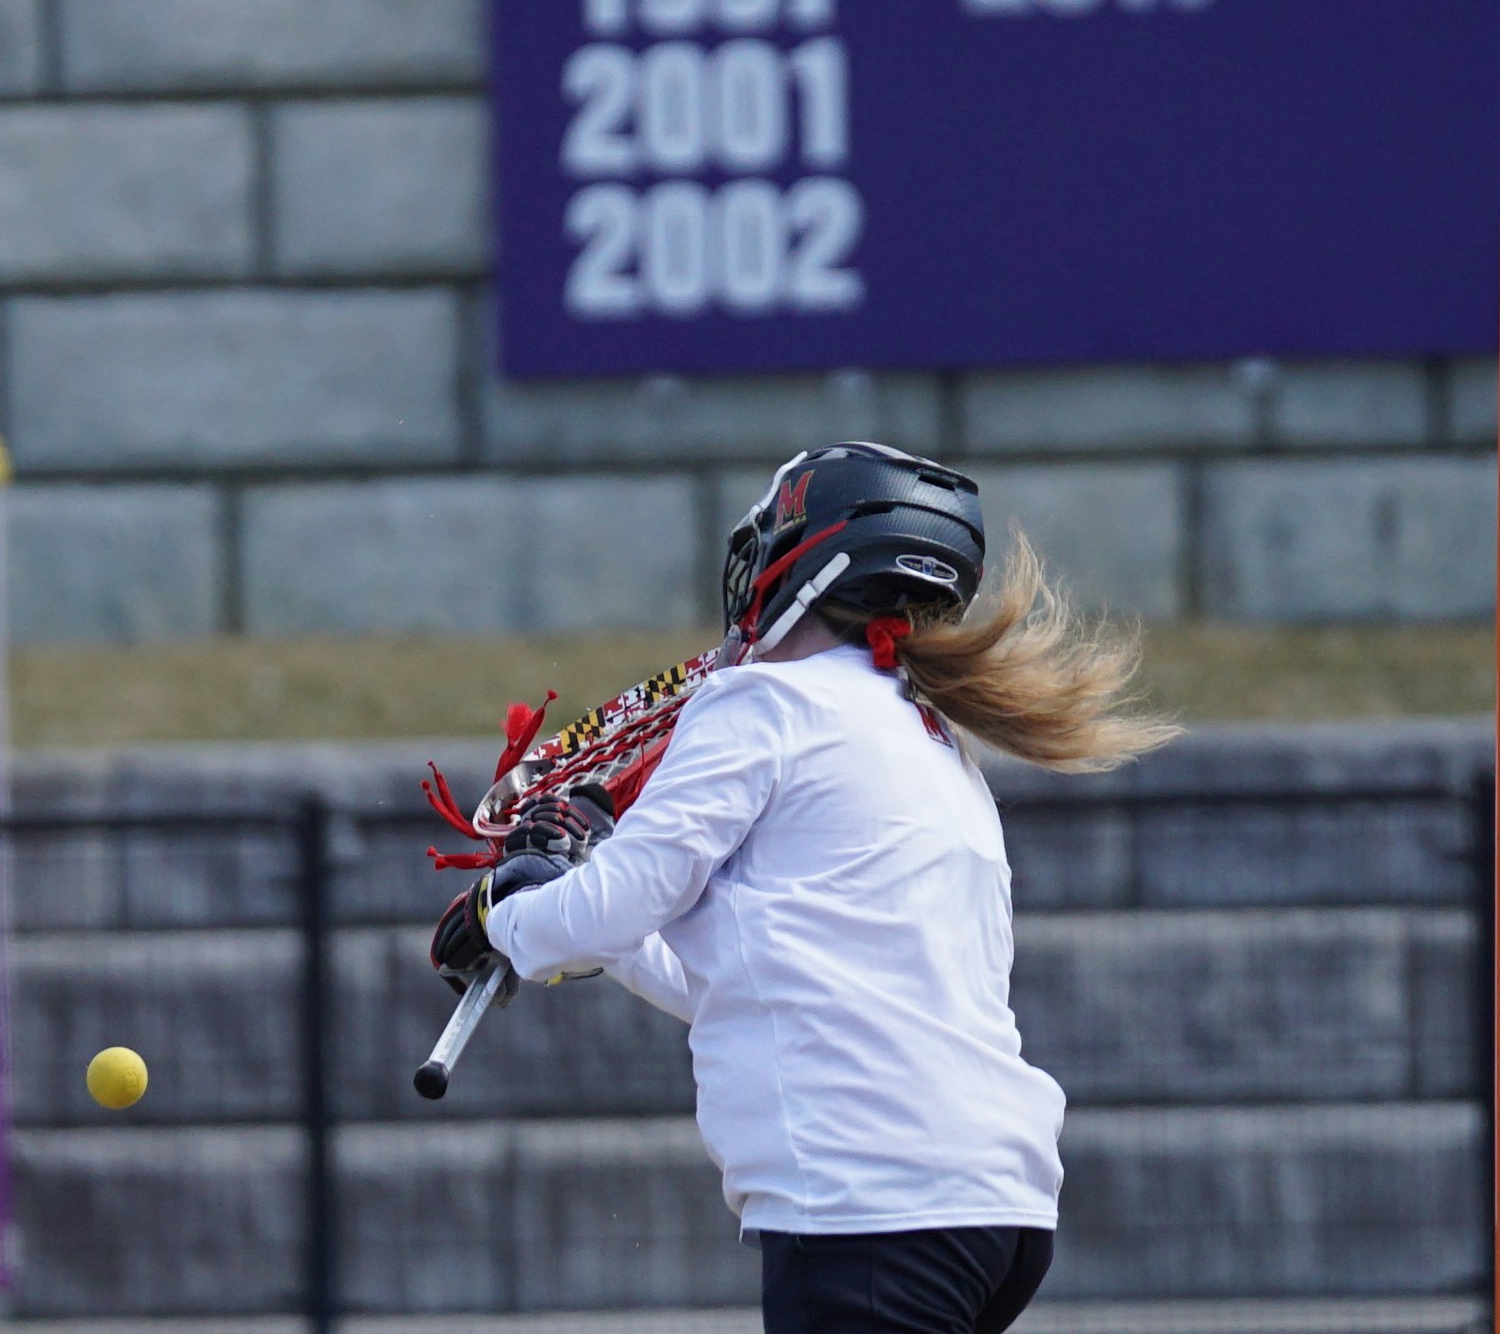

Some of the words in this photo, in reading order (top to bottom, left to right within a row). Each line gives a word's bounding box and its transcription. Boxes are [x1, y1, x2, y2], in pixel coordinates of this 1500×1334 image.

[563, 38, 846, 175] 2001
[566, 179, 862, 315] 2002
[773, 470, 815, 531] M
